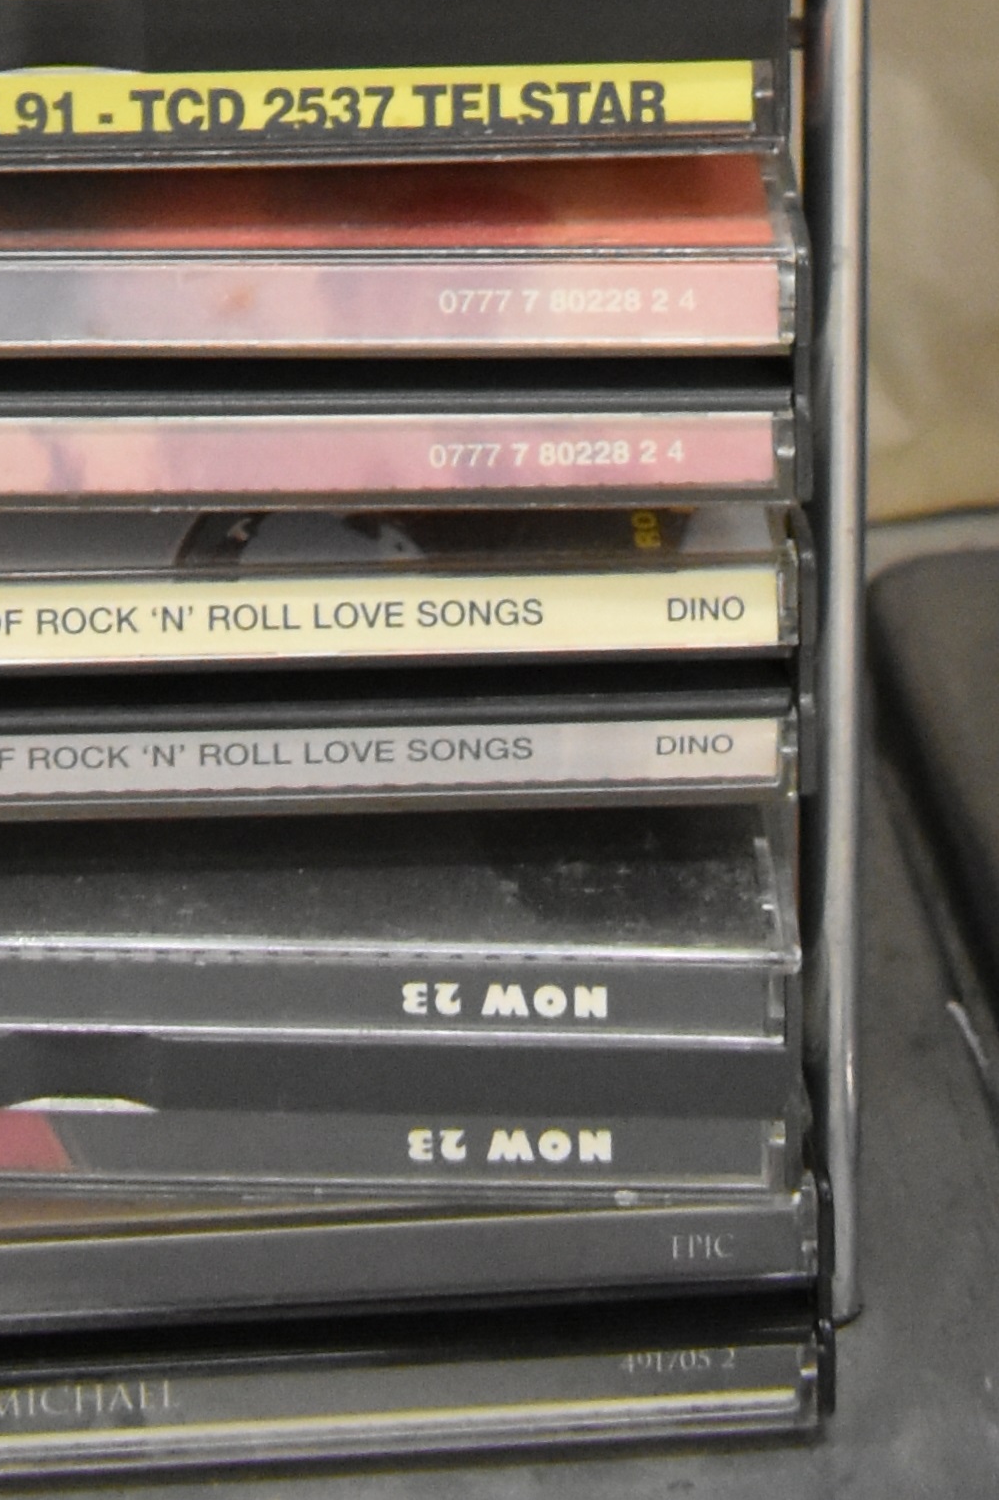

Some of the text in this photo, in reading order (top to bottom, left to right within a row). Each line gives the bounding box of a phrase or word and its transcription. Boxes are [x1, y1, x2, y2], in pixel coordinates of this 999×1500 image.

[36, 606, 139, 636] ROCK
[207, 603, 301, 631] ROLL
[313, 601, 404, 629] LOVE
[416, 598, 544, 628] SONGS
[666, 594, 745, 622] DINO
[656, 733, 735, 757] DINO
[401, 982, 608, 1019] NOW 23
[407, 1129, 613, 1163] NOW 23
